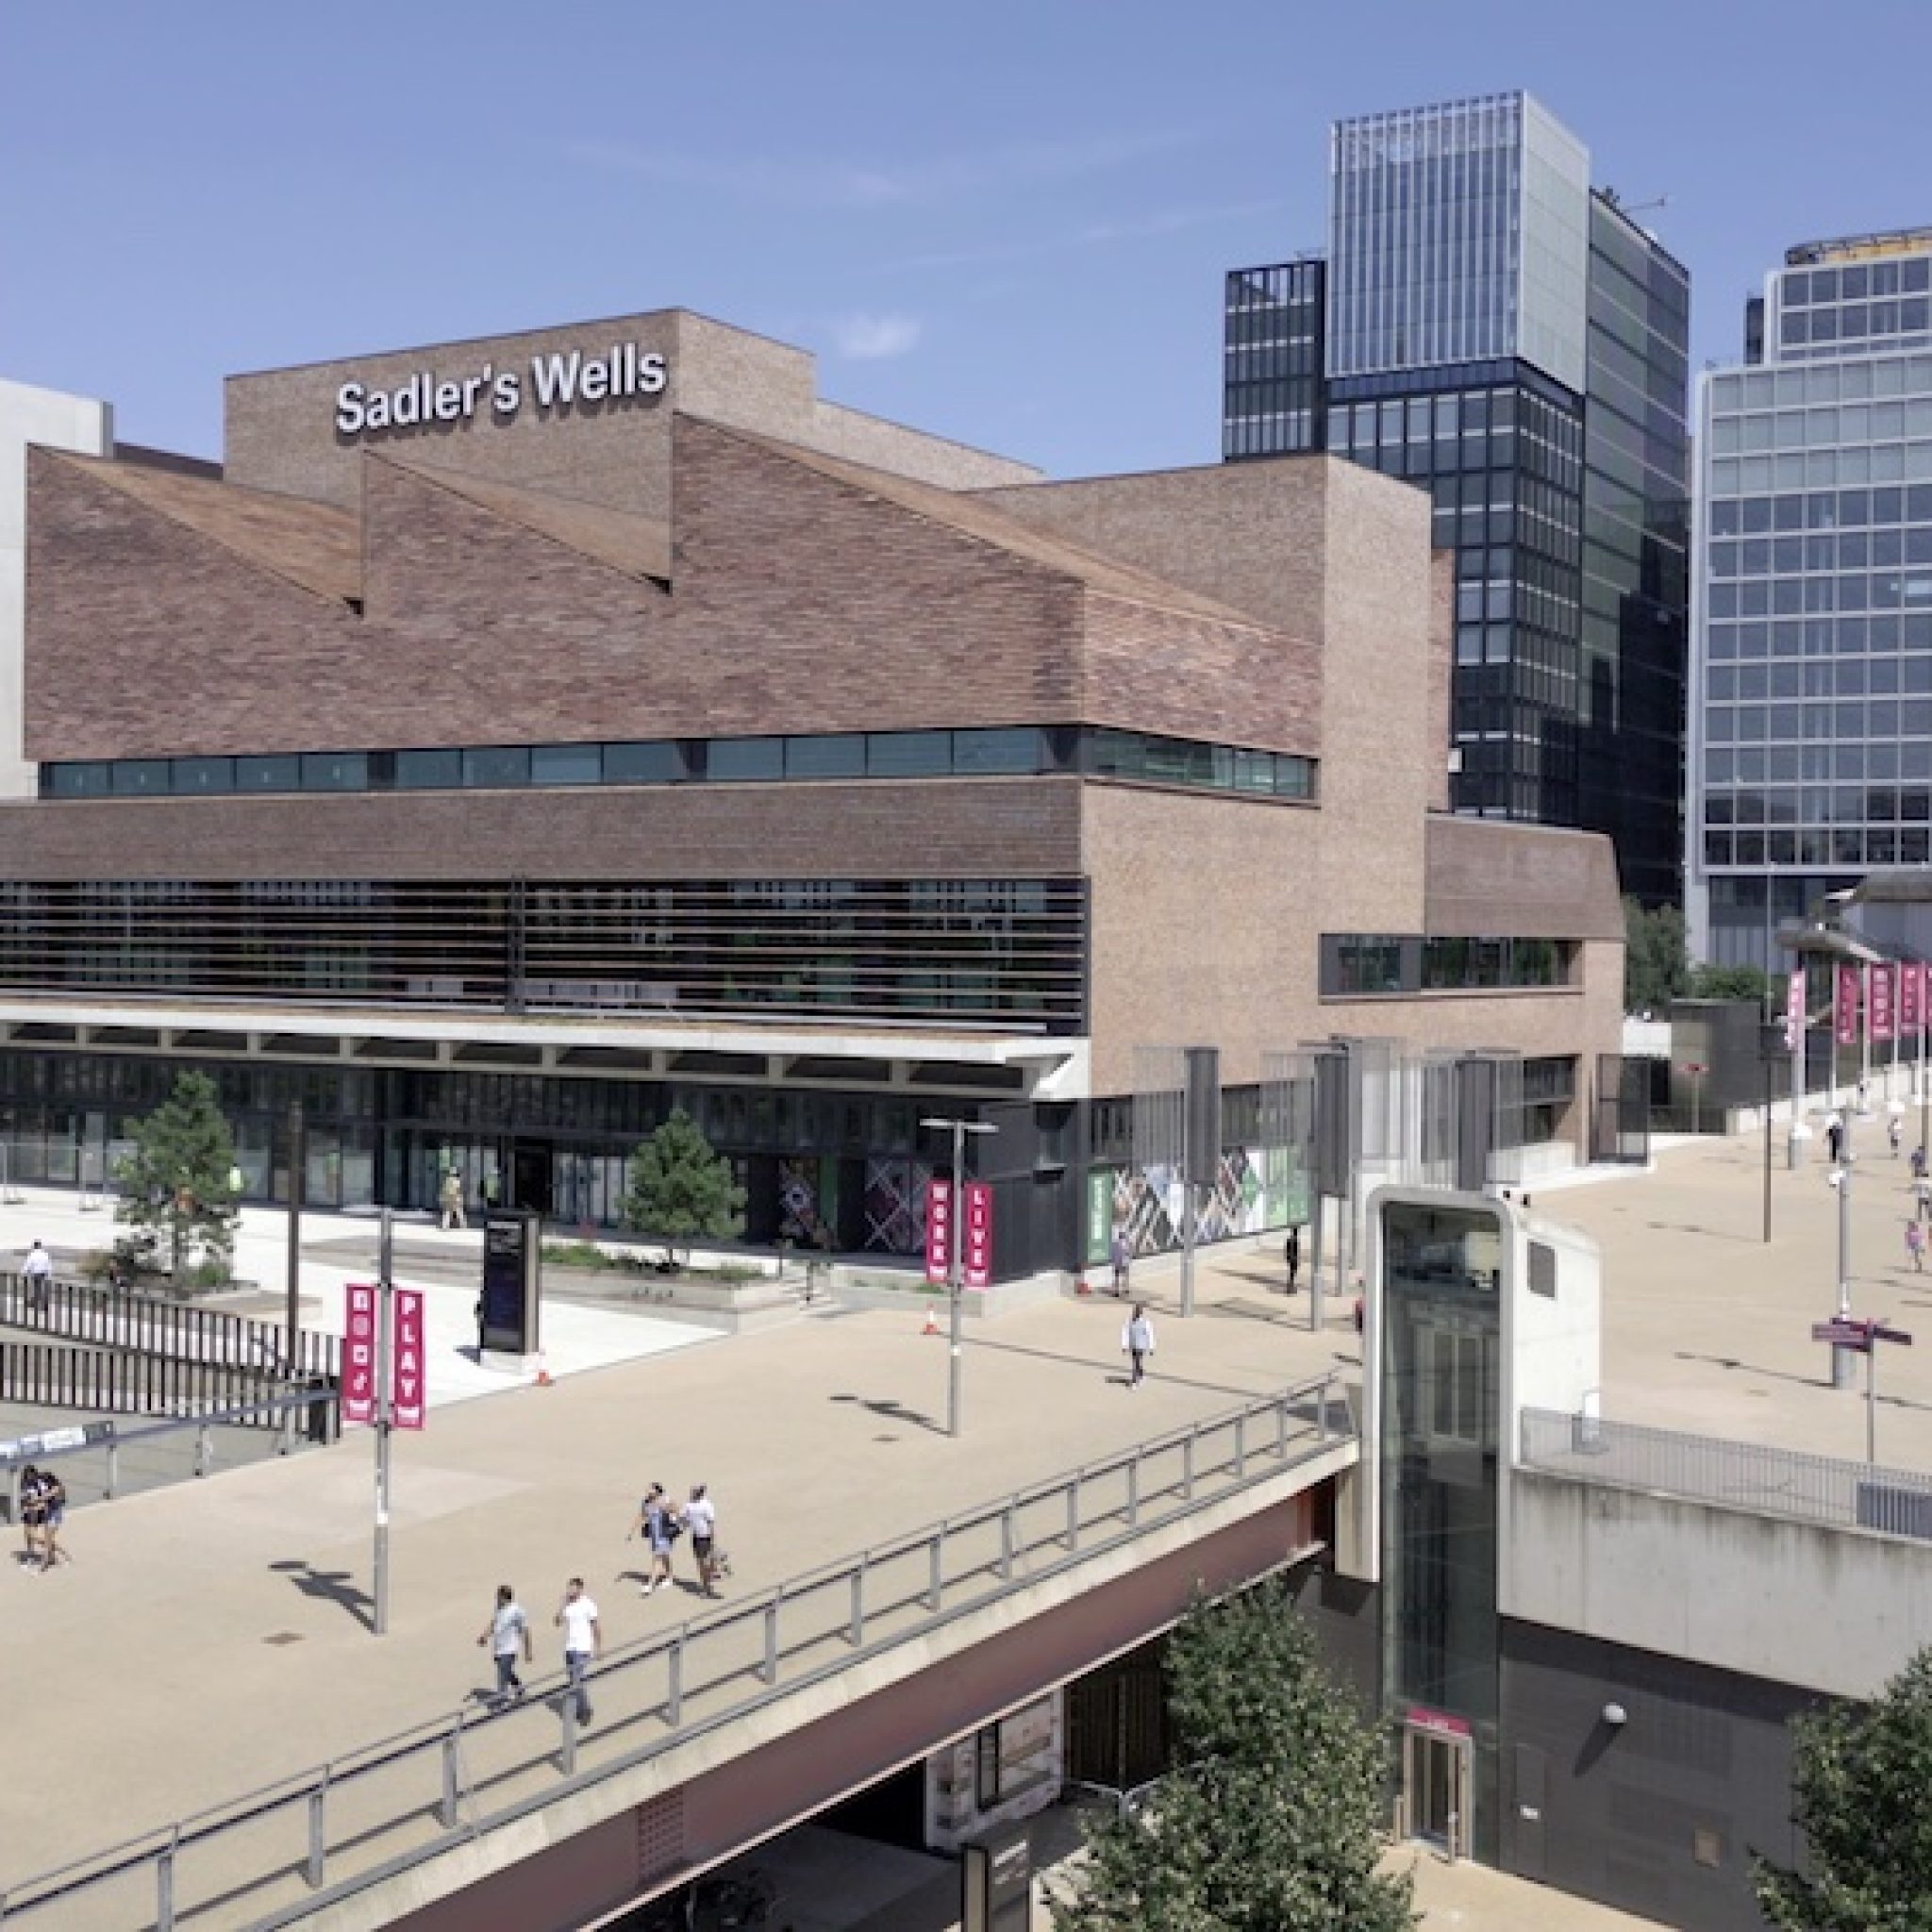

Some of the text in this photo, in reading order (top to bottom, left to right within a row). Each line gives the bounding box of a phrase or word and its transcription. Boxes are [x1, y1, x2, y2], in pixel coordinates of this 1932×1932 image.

[337, 342, 666, 433] Sadler's Wells
[971, 1189, 986, 1266] LIVE
[400, 1296, 416, 1399] PLAY
